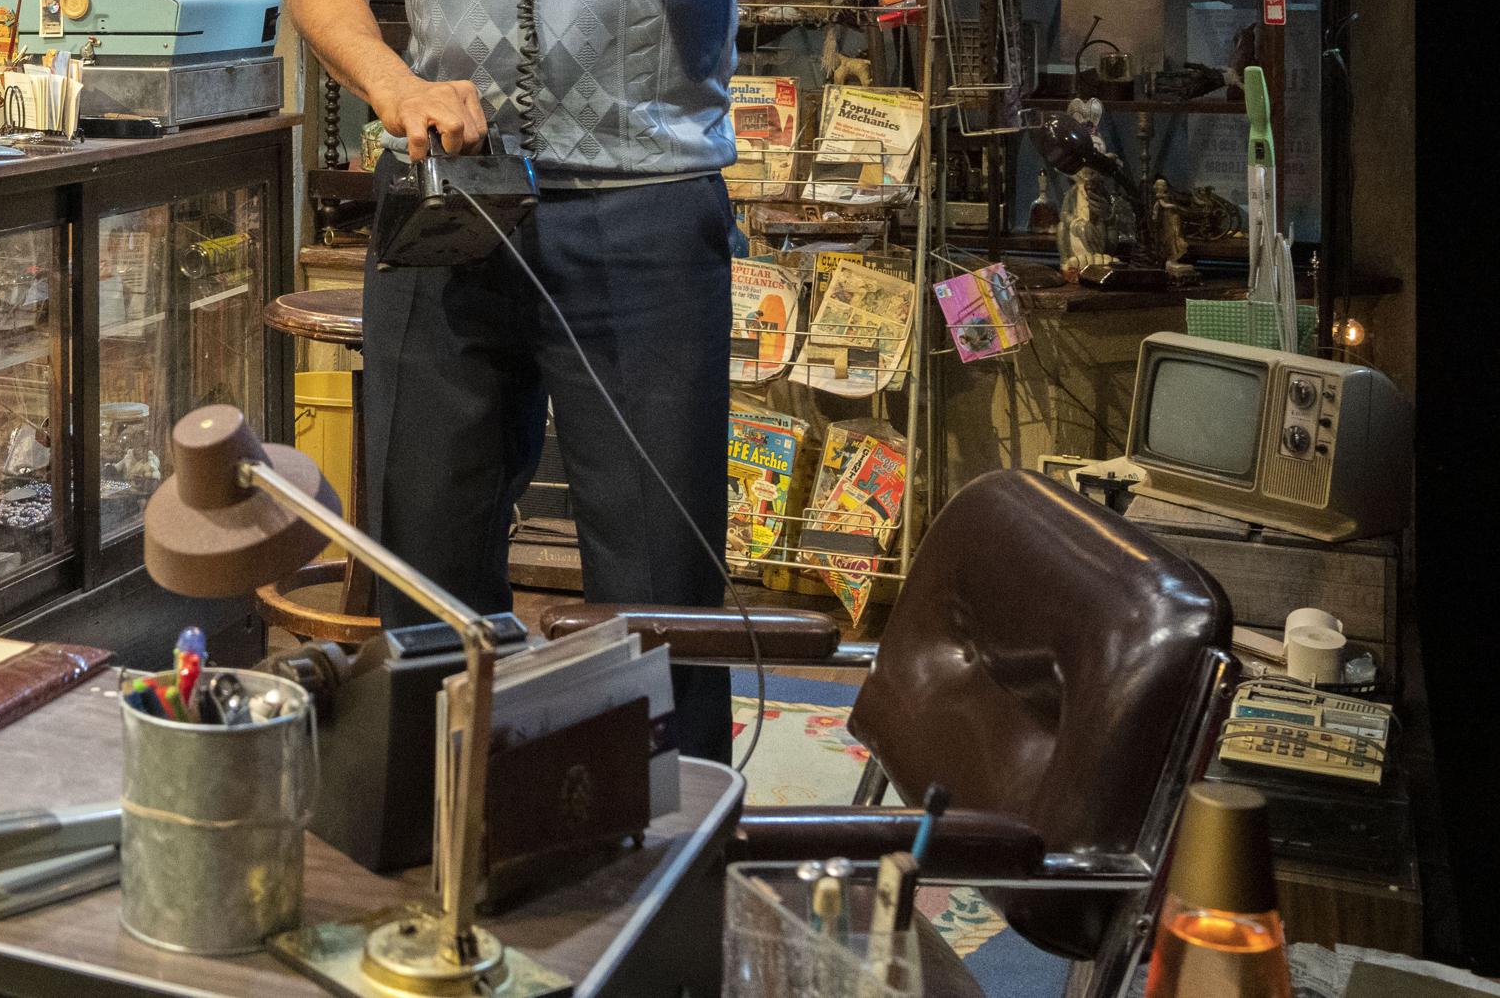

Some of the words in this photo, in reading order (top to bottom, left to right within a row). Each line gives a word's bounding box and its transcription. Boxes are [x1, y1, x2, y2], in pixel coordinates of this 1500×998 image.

[730, 84, 761, 95] pular
[731, 93, 776, 104] chanics
[840, 99, 888, 119] Popular
[838, 108, 901, 131] Mechanics
[731, 266, 772, 278] OPULAR
[731, 275, 785, 289] ECHANICS
[750, 447, 789, 471] Archie
